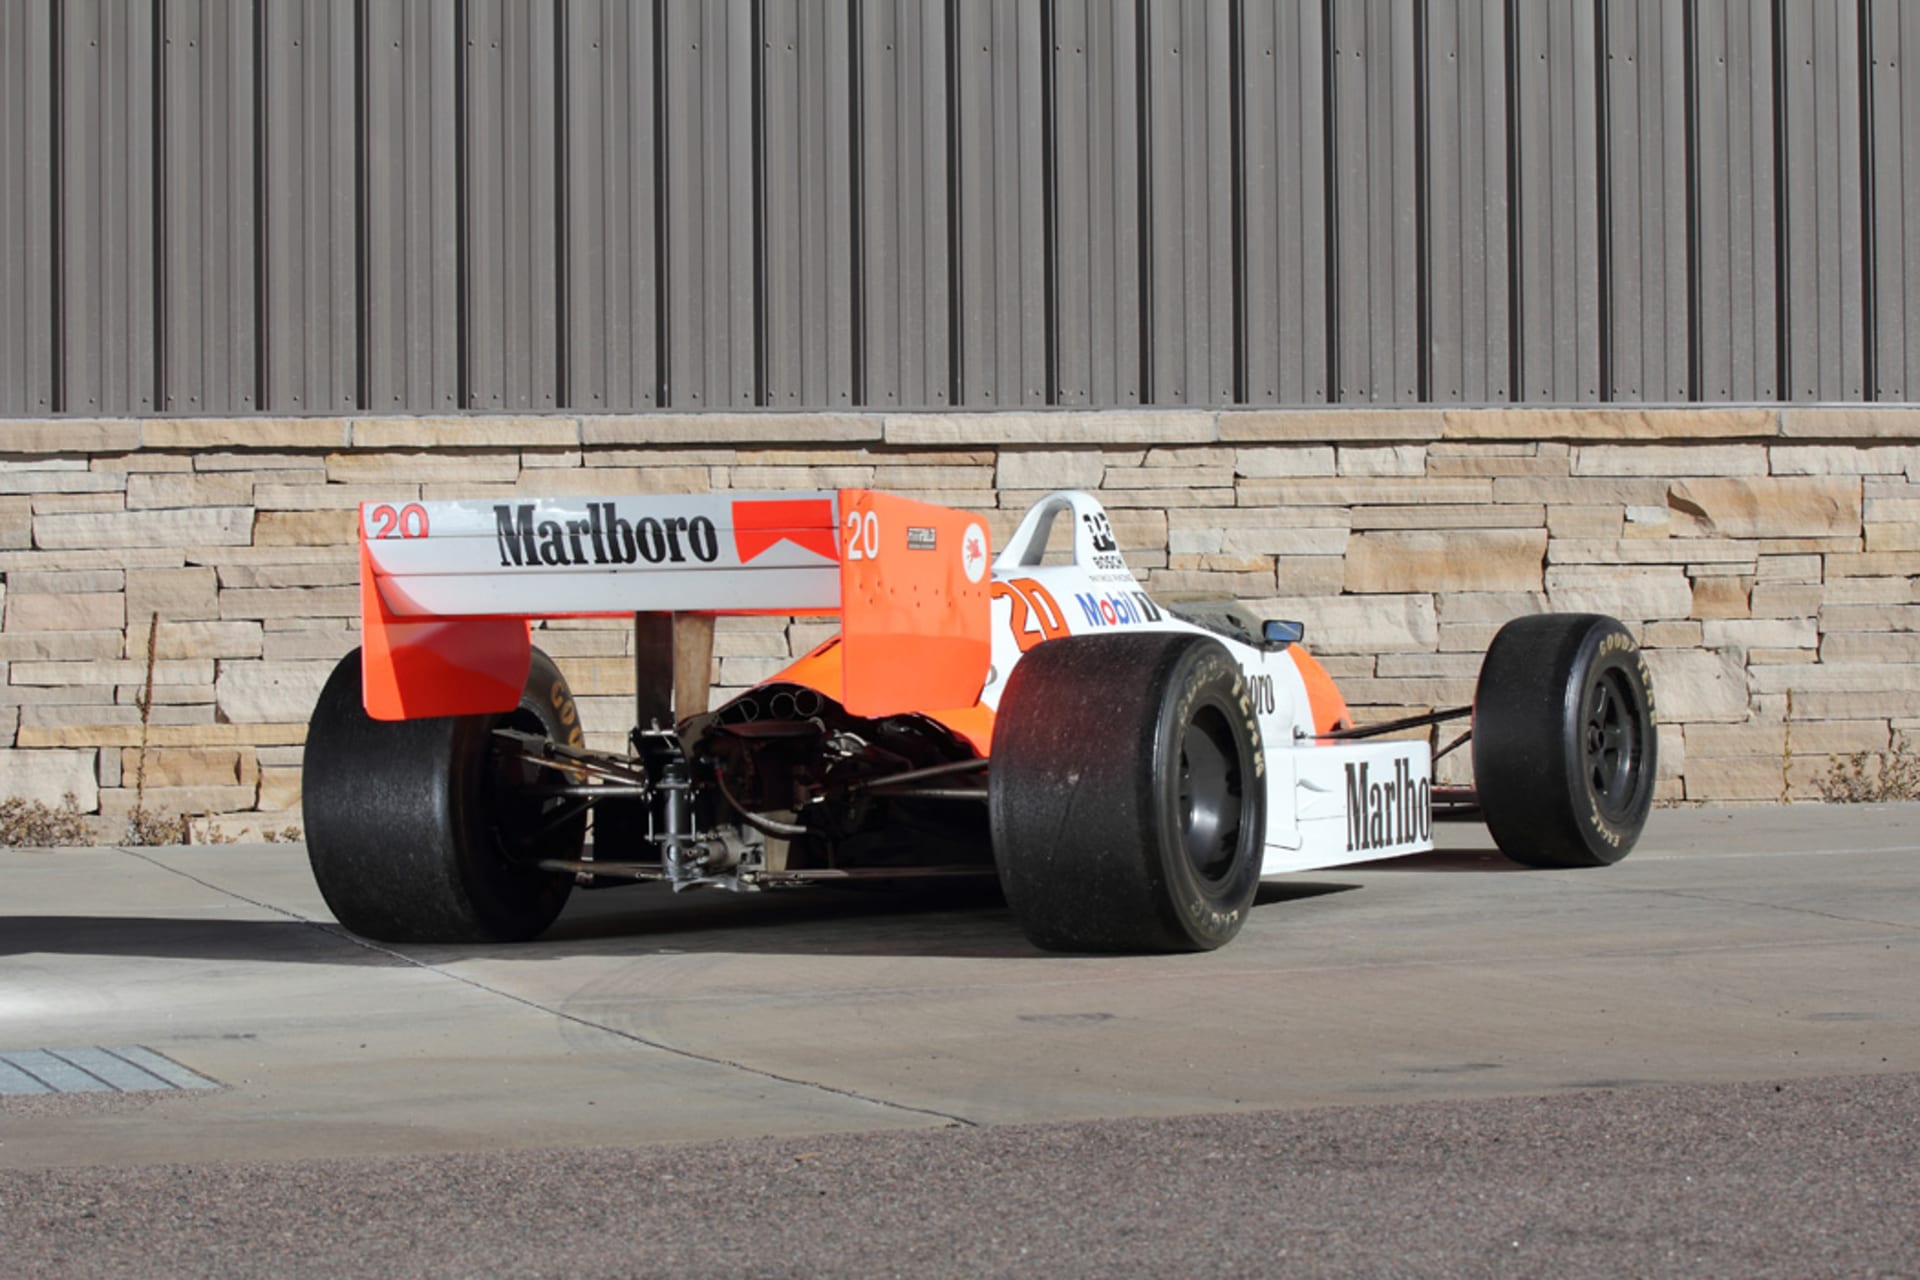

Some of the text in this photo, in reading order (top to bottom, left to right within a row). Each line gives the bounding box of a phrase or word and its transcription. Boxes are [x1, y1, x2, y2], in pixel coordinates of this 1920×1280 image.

[371, 503, 429, 538] 20
[493, 502, 719, 566] Marlboro
[846, 510, 879, 560] 20
[990, 577, 1071, 653] 20
[1074, 591, 1141, 627] Mobil
[1344, 757, 1434, 852] Marlbo
